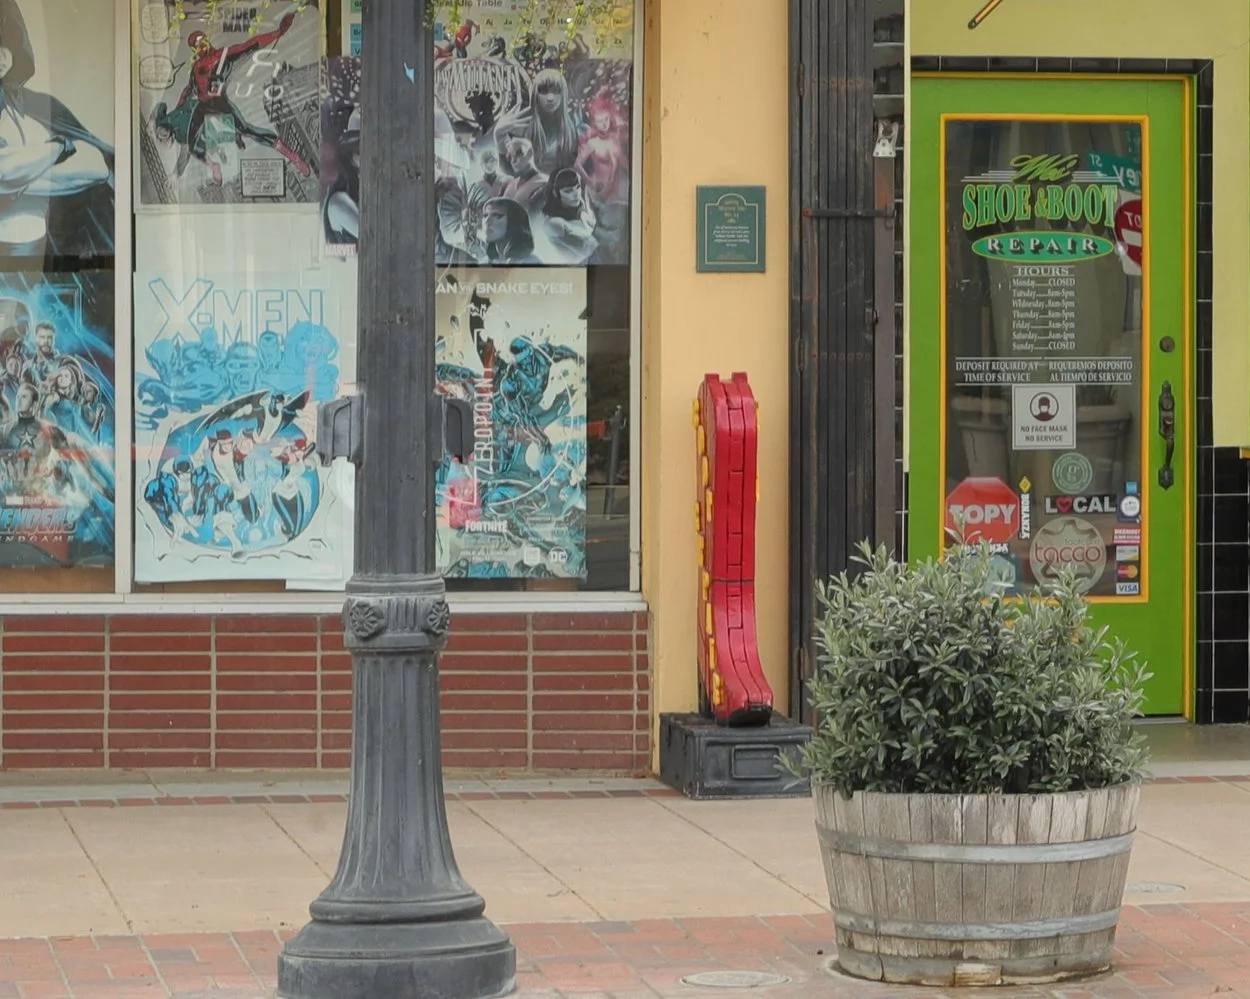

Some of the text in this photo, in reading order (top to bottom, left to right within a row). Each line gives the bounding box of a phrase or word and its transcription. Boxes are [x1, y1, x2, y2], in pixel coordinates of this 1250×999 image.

[963, 184, 1031, 231] SHOE
[987, 238, 1098, 253] REPAIR
[1018, 266, 1069, 277] HOURS
[1048, 278, 1075, 287] CLOSED
[148, 277, 325, 352] X-MEN
[1048, 341, 1075, 350] CLOSED
[955, 361, 1038, 371] DEPOSIT REQUIRED AT
[1098, 360, 1133, 370] DEPOSITO
[964, 373, 1031, 382] TIME OF SERVICE
[1088, 372, 1098, 382] DE
[1099, 372, 1132, 382] SERVICIO
[1021, 425, 1068, 433] NO FACE MASK
[1025, 434, 1063, 442] NO SERVICE
[950, 504, 1016, 524] TOPY
[1034, 543, 1100, 564] tacco
